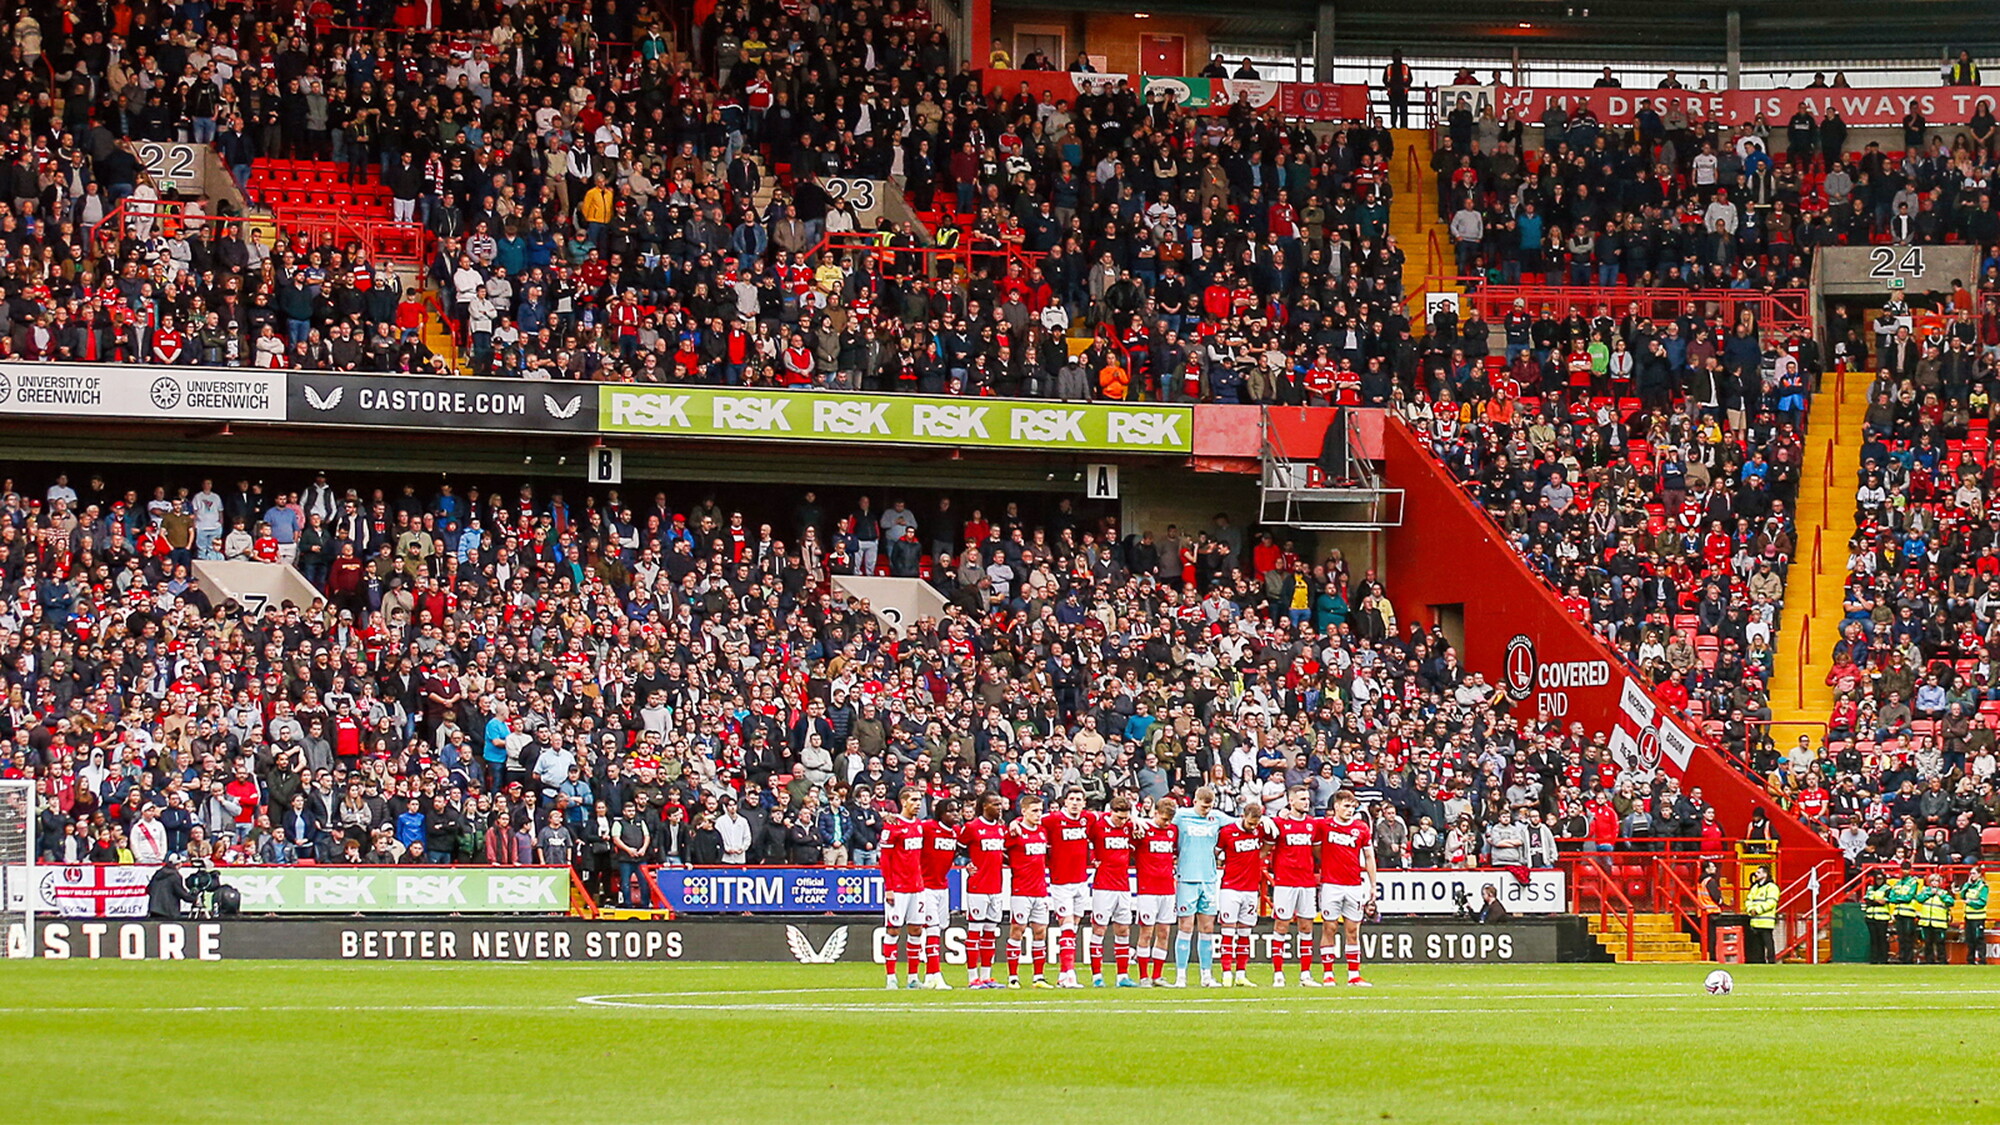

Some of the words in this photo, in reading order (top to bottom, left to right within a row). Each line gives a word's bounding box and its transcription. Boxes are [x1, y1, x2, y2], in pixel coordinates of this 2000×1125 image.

[1609, 96, 1737, 120] DESRE,
[1754, 97, 1781, 117] IS
[139, 143, 195, 179] 22
[826, 177, 876, 212] 23
[1869, 246, 1926, 278] 24
[17, 375, 83, 389] UNIVERSITY
[85, 377, 100, 390] OF
[187, 380, 252, 395] UNIVERSITY
[254, 382, 269, 394] OF
[17, 388, 101, 405] GREENWICH
[187, 393, 269, 409] GREENWICH
[359, 388, 525, 414] CASTORE.COM
[612, 393, 691, 427] RSK
[713, 396, 791, 430] RSK
[813, 400, 891, 434] RSK
[913, 404, 989, 438] RSK
[1011, 408, 1087, 442] RSK
[1107, 411, 1182, 445] RSK
[599, 450, 612, 480] B
[1096, 466, 1109, 496] A
[1538, 660, 1610, 688] COVERED
[1538, 692, 1568, 717] END
[1062, 827, 1087, 841] RSK
[1105, 836, 1129, 850] RSK
[1234, 837, 1261, 853] RSK
[1286, 833, 1312, 846] RSK
[1328, 831, 1357, 848] RSK
[1150, 840, 1173, 853] RSK
[304, 875, 376, 905] RSK
[396, 875, 467, 905] RSK
[488, 875, 558, 905] RSK
[710, 876, 783, 905] ITRM
[791, 886, 799, 895] IT
[801, 886, 829, 895] Partner
[796, 878, 824, 887] Official
[795, 895, 803, 904] of
[804, 895, 826, 904] CAFC
[341, 931, 457, 958] BETTER
[472, 931, 571, 959] NEVER
[586, 932, 683, 958] STOPS
[1427, 933, 1513, 959] STOPS
